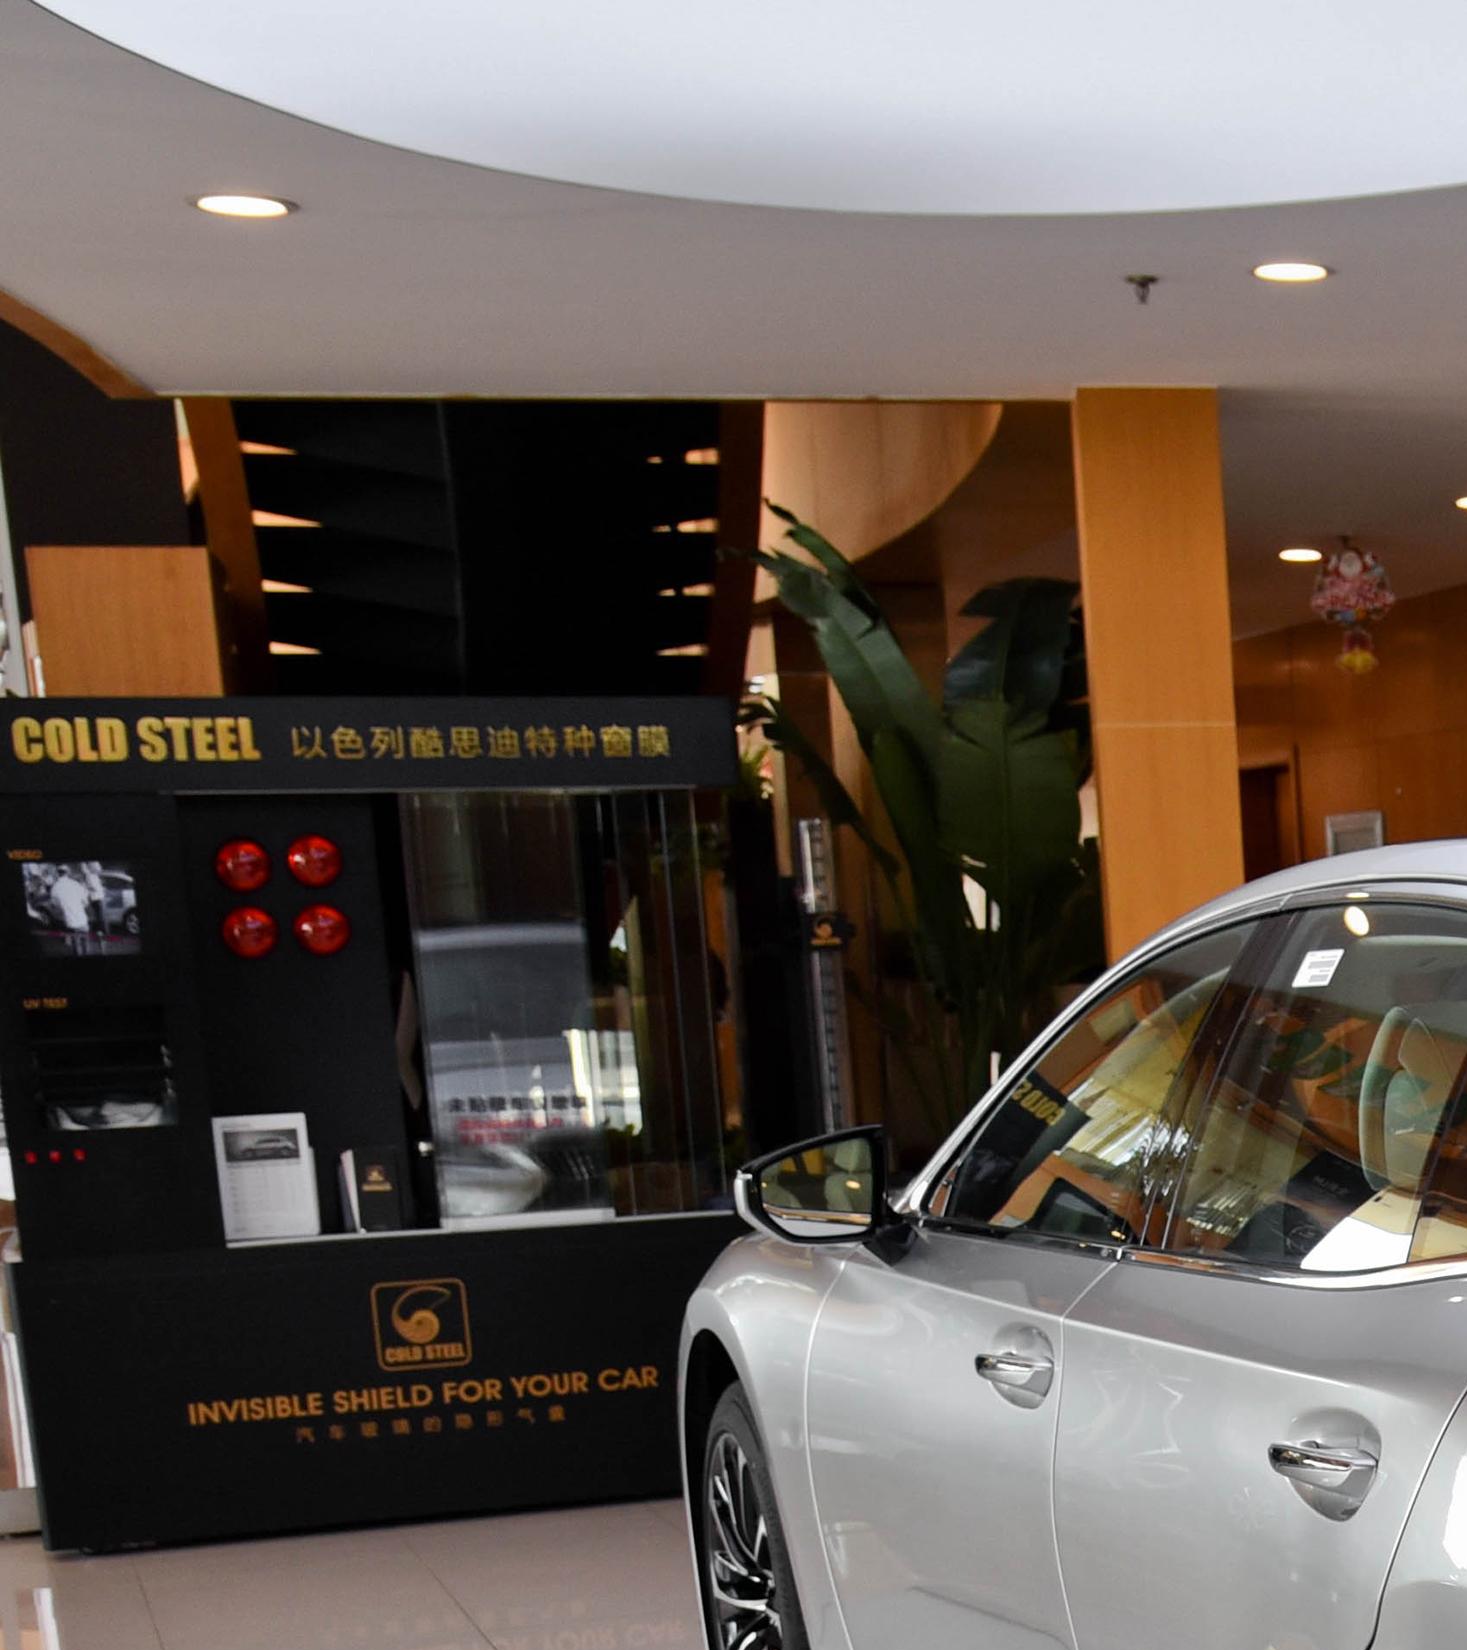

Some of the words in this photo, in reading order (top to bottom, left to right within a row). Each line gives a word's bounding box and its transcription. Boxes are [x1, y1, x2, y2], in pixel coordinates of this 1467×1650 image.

[11, 716, 128, 763] COLD
[136, 716, 262, 762] STEEL
[291, 724, 671, 761] 以色列酷思迪特种窗膜
[187, 1391, 324, 1426] INVISIBLE
[332, 1383, 434, 1415] SHIELD
[441, 1378, 503, 1405] FOR
[509, 1371, 590, 1399] YOUR
[597, 1365, 660, 1392] CAR
